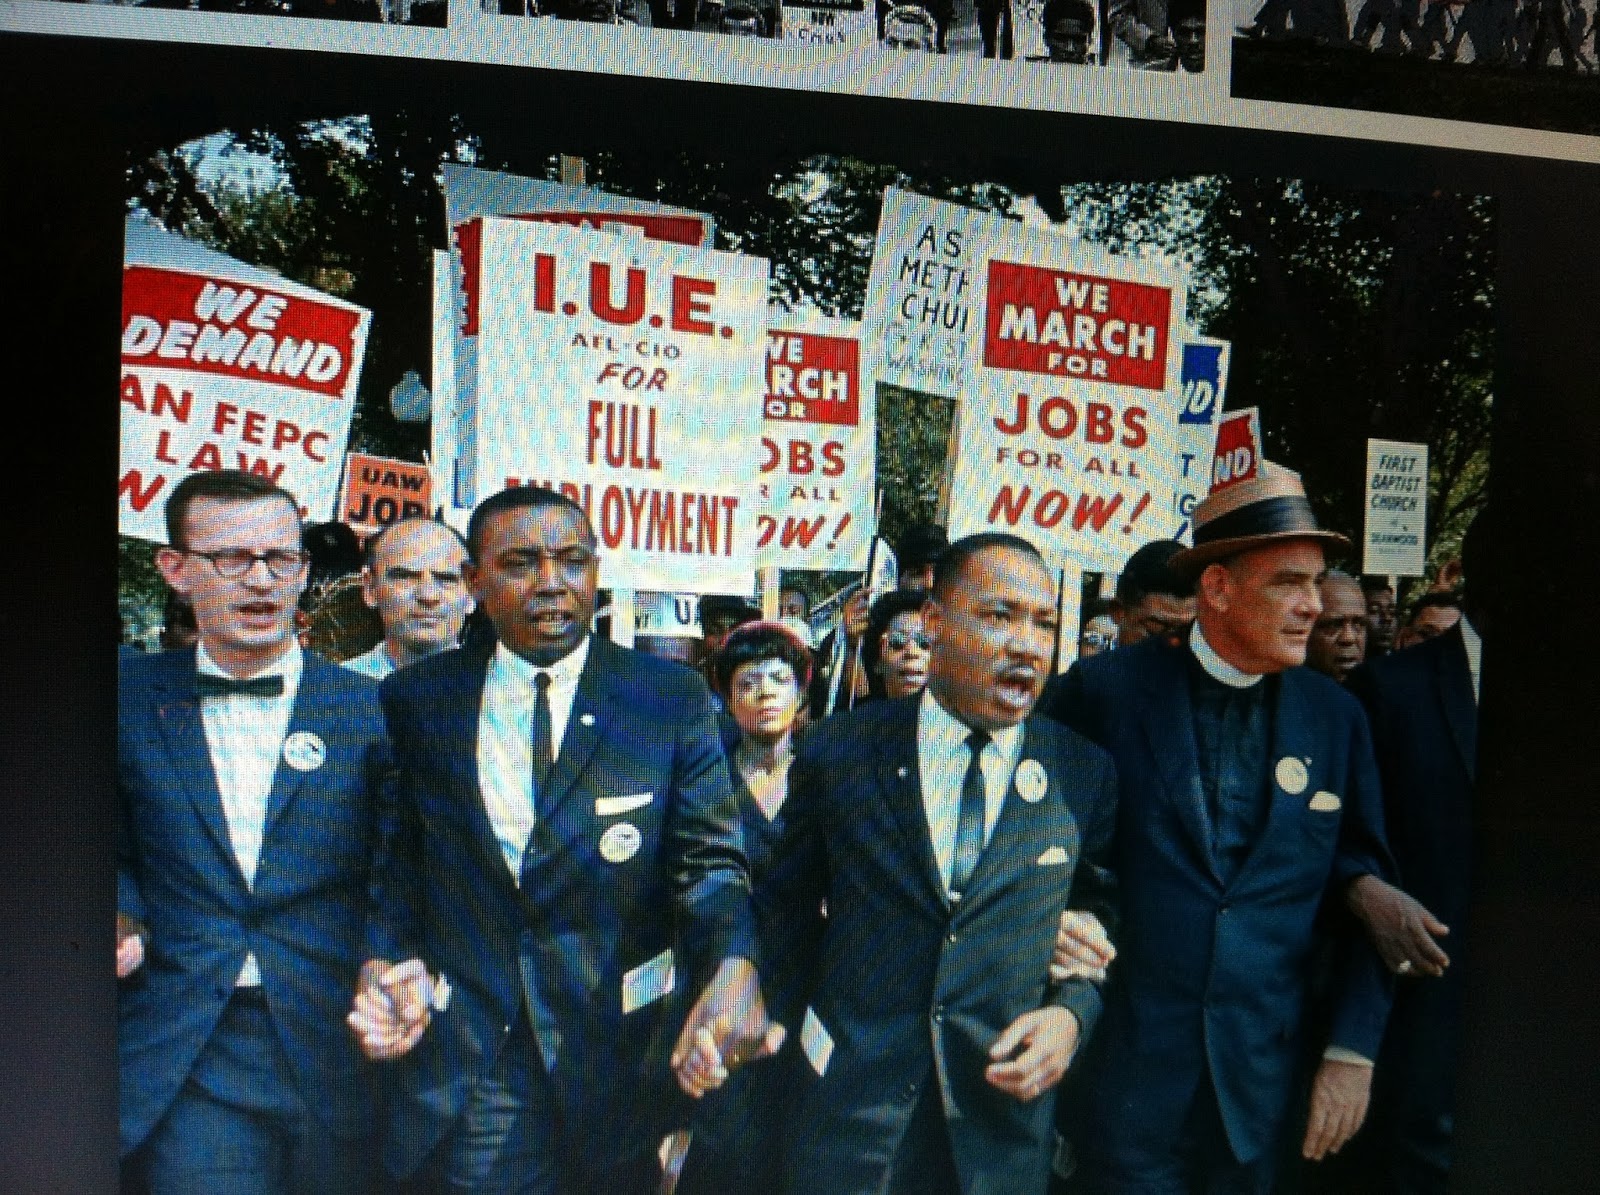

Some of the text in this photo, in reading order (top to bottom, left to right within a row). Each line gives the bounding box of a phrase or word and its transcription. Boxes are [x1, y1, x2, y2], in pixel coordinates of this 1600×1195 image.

[917, 225, 961, 258] AS
[195, 281, 288, 331] WE
[534, 252, 734, 340] I.U.E.
[1055, 277, 1110, 313] WE
[121, 315, 343, 382] DEMAND
[999, 302, 1156, 361] MARCH
[597, 362, 668, 392] FOR
[1049, 352, 1110, 378] FOR
[768, 364, 848, 403] RCH
[120, 374, 330, 463] AN FEPC
[587, 399, 662, 470] FULL
[993, 393, 1148, 449] JOBS
[156, 431, 286, 486] LAW
[996, 447, 1141, 478] FOR ALL
[1379, 454, 1418, 472] FIRST
[362, 467, 427, 491] UAW
[790, 485, 842, 502] ALL
[1371, 472, 1421, 493] BAPTIST
[349, 494, 431, 525] JOB
[987, 485, 1152, 535] NOW!
[1370, 493, 1419, 512] CHURCH
